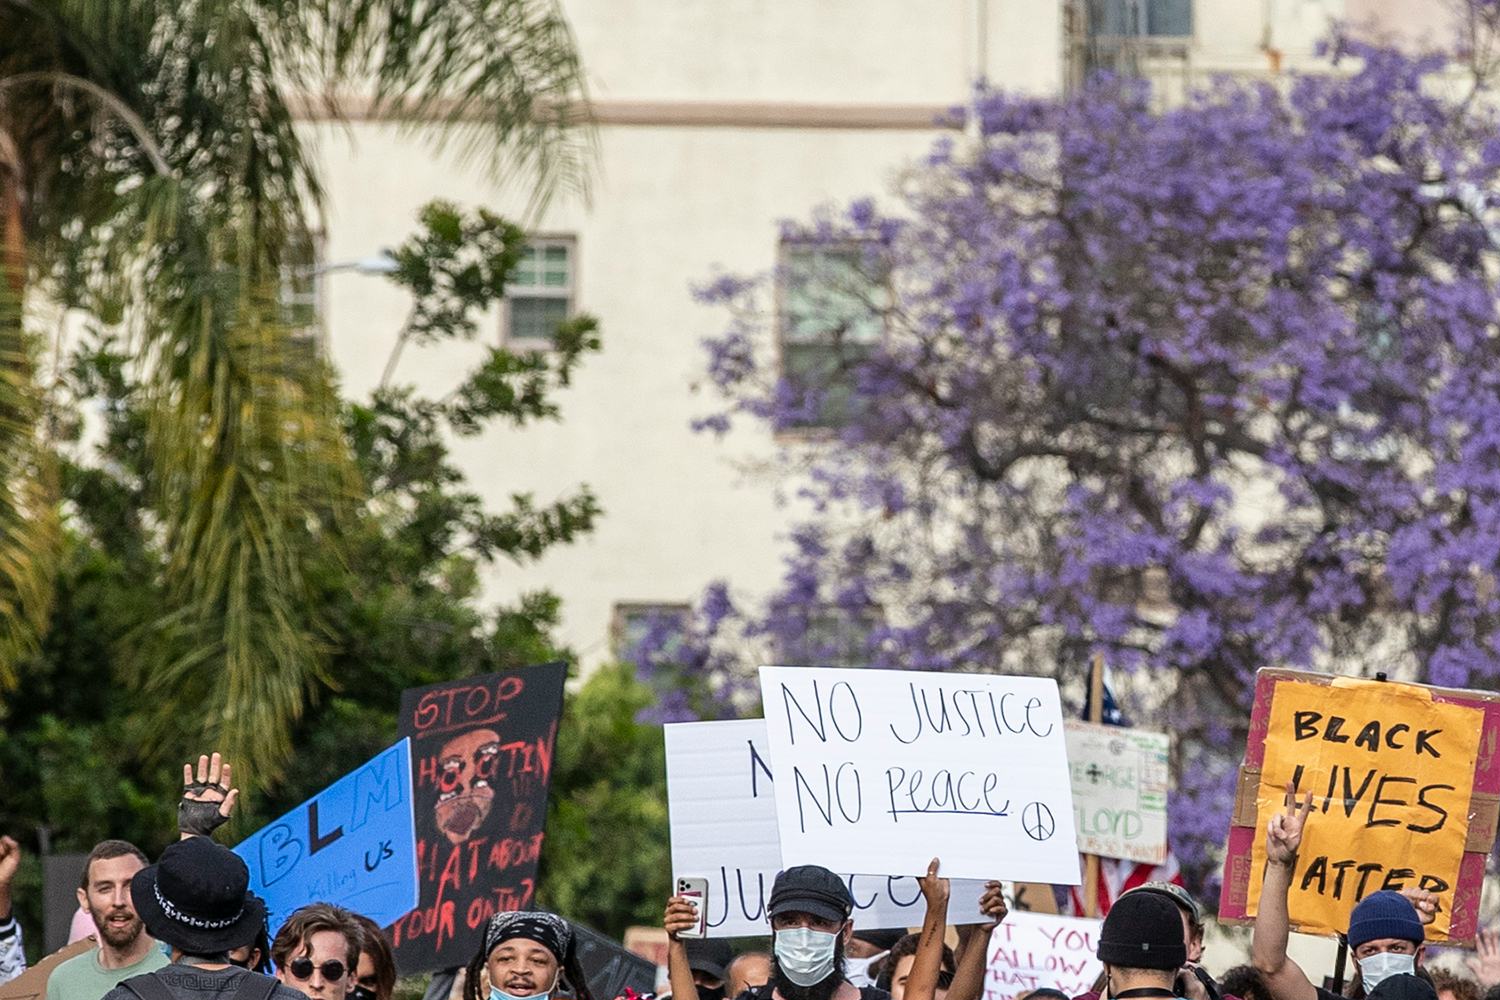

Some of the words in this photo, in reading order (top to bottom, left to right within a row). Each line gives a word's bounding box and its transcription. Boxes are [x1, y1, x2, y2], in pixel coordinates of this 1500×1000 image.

[414, 677, 524, 729] STOP
[781, 679, 862, 745] NO
[1294, 710, 1443, 758] BLACK
[260, 749, 402, 888] BLM
[793, 761, 862, 833] NO
[1077, 806, 1143, 840] LOYD
[1284, 764, 1456, 834] LIVES
[364, 840, 394, 872] US
[990, 947, 1087, 976] ALLOW
